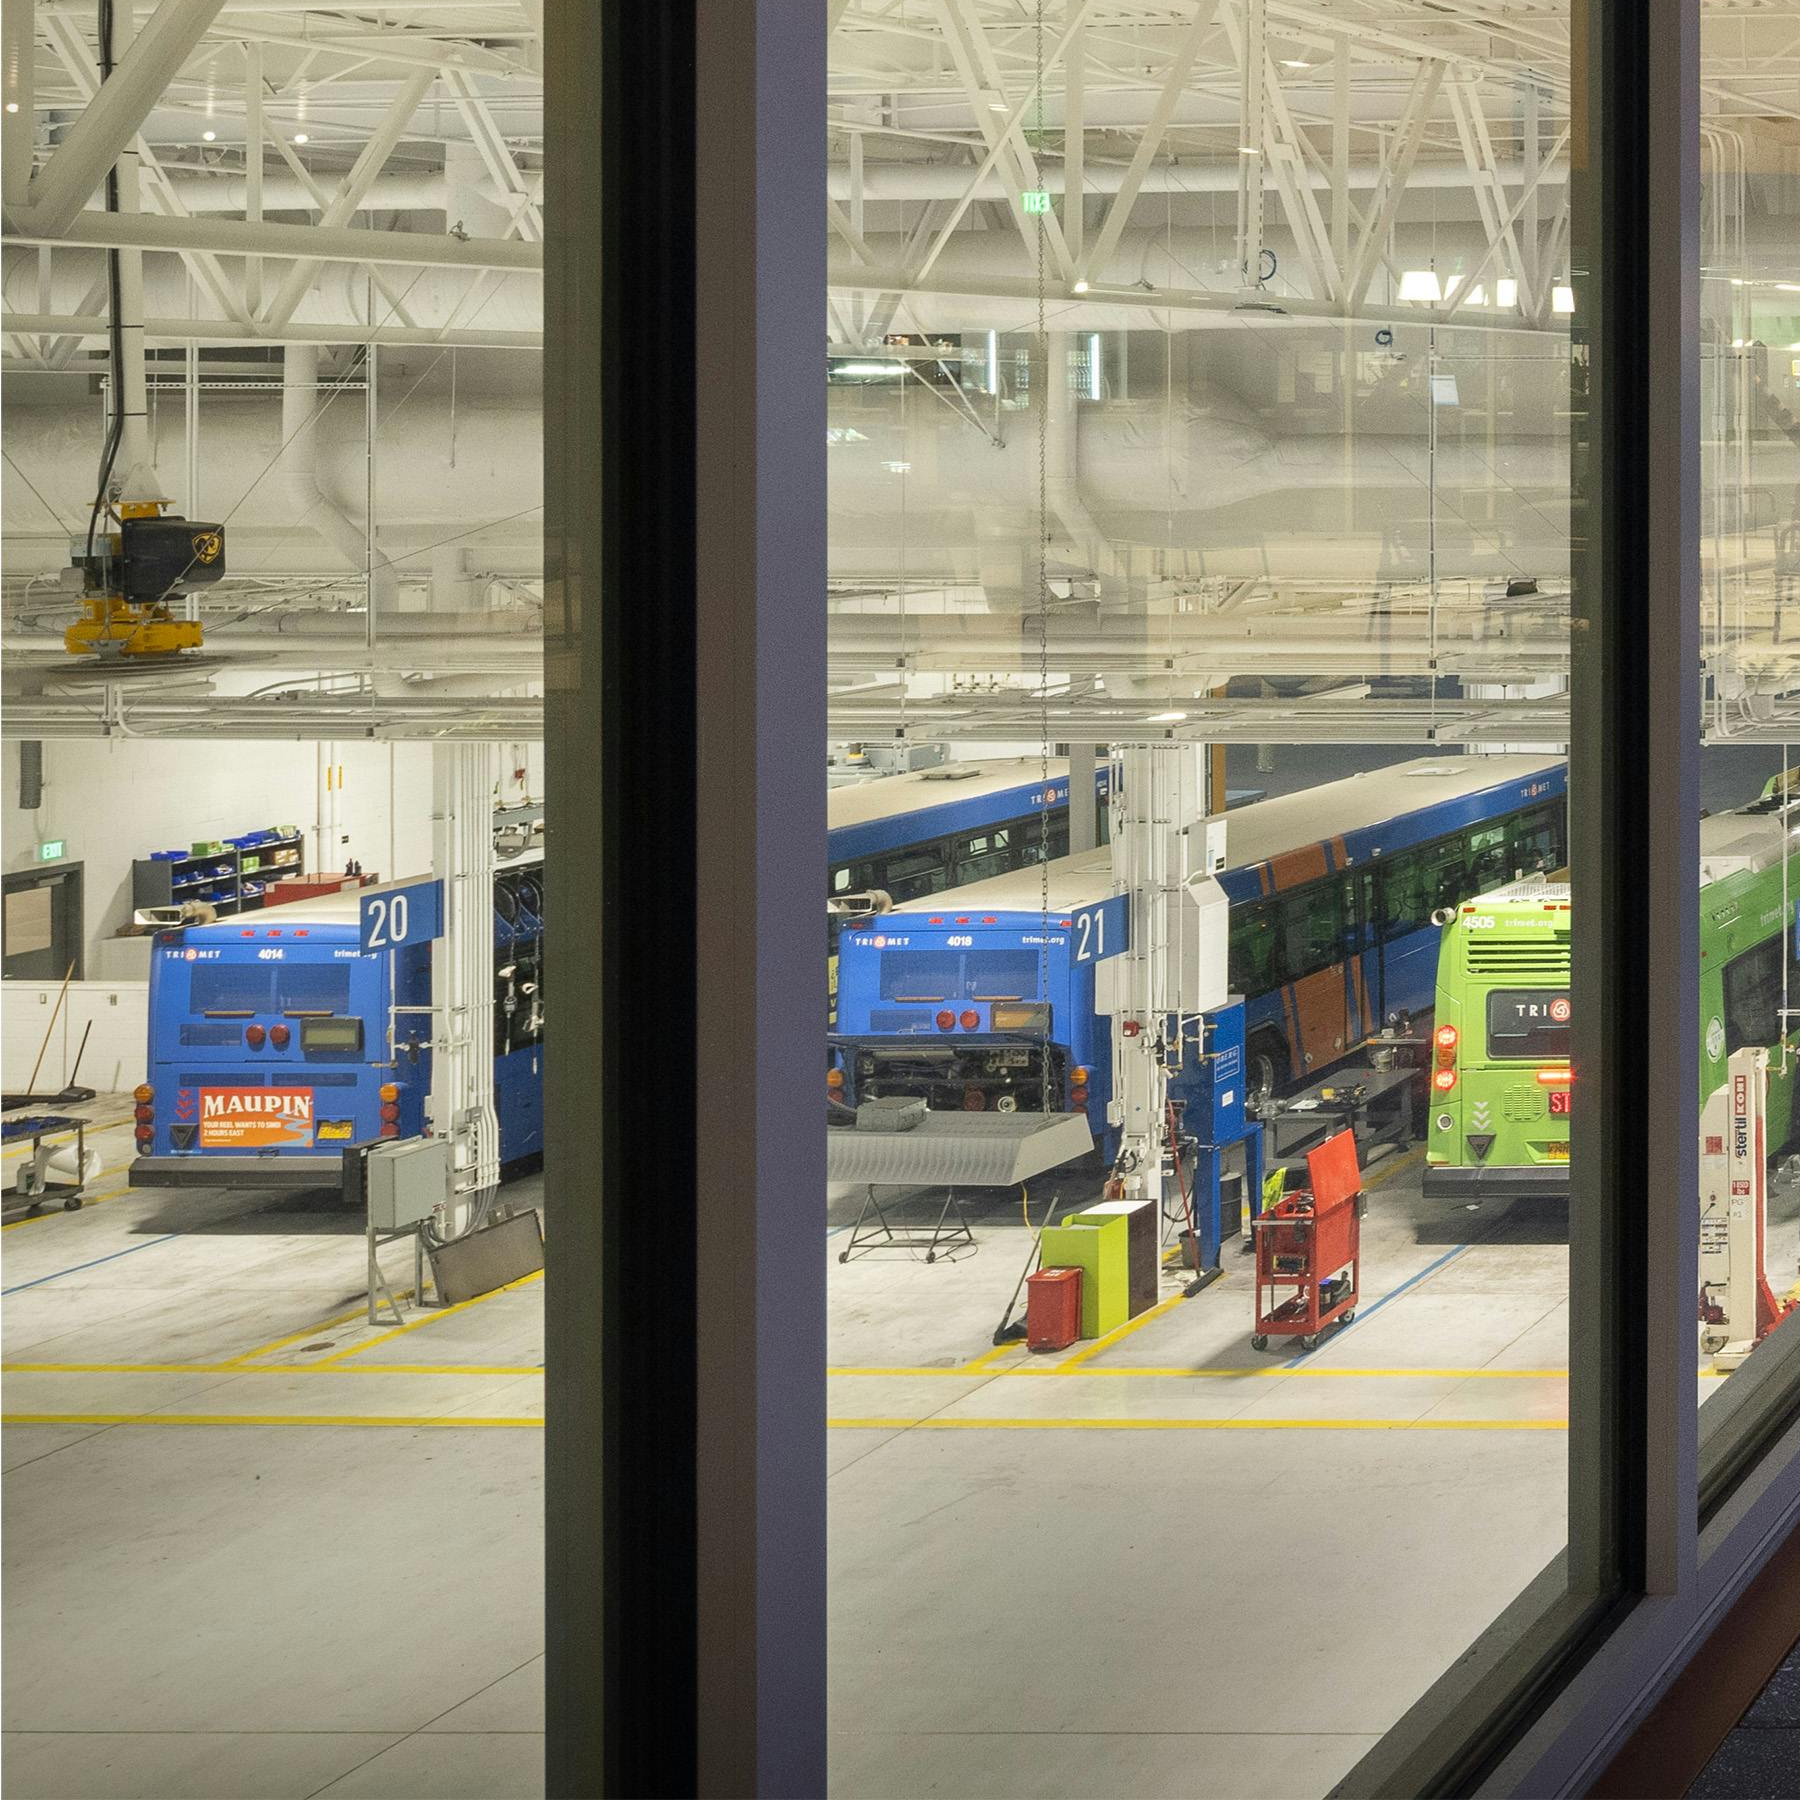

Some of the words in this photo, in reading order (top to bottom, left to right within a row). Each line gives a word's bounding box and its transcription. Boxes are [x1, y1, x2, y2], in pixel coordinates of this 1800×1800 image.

[42, 841, 64, 860] EXIT
[367, 894, 408, 949] 20
[1462, 916, 1495, 929] 4505
[1503, 919, 1553, 929] trimet.org
[856, 937, 873, 946] TRI
[887, 937, 910, 946] MET
[947, 935, 973, 947] 4018
[1076, 908, 1105, 962] 21
[166, 950, 184, 959] TRI
[198, 950, 221, 959] MET
[258, 948, 284, 960] 4014
[334, 949, 378, 960] trimetg
[1515, 1004, 1547, 1017] TRI
[1735, 1076, 1746, 1115] KONI
[203, 1095, 311, 1119] MAUPIN
[1551, 1093, 1570, 1113] ST
[203, 1121, 218, 1129] YOUR
[234, 1121, 257, 1129] WANTS
[257, 1121, 265, 1129] TO
[1735, 1117, 1747, 1157] stertil
